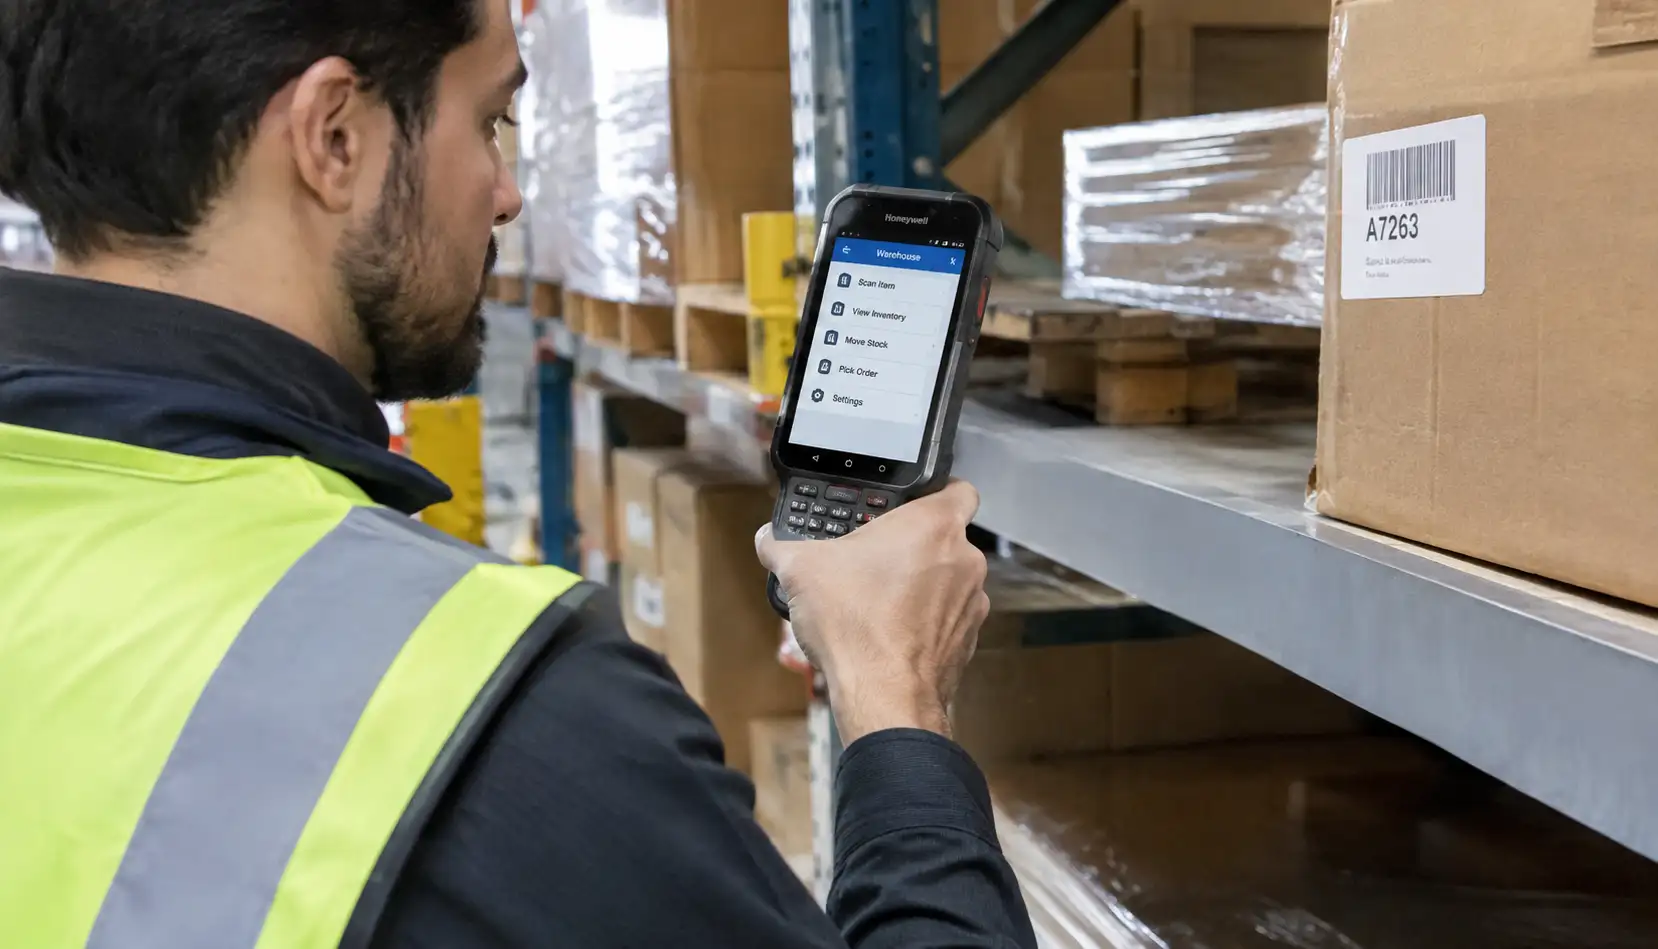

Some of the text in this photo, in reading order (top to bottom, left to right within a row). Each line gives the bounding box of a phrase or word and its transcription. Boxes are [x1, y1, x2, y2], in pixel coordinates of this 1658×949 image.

[885, 213, 928, 225] Honeywell
[1366, 213, 1418, 242] A7263
[876, 249, 921, 262] Warehouse
[858, 278, 896, 290] Scan Item
[853, 307, 906, 322] View Inventory
[845, 336, 888, 349] Move Stock
[839, 365, 878, 378] Pick Order
[833, 394, 863, 407] Settings
